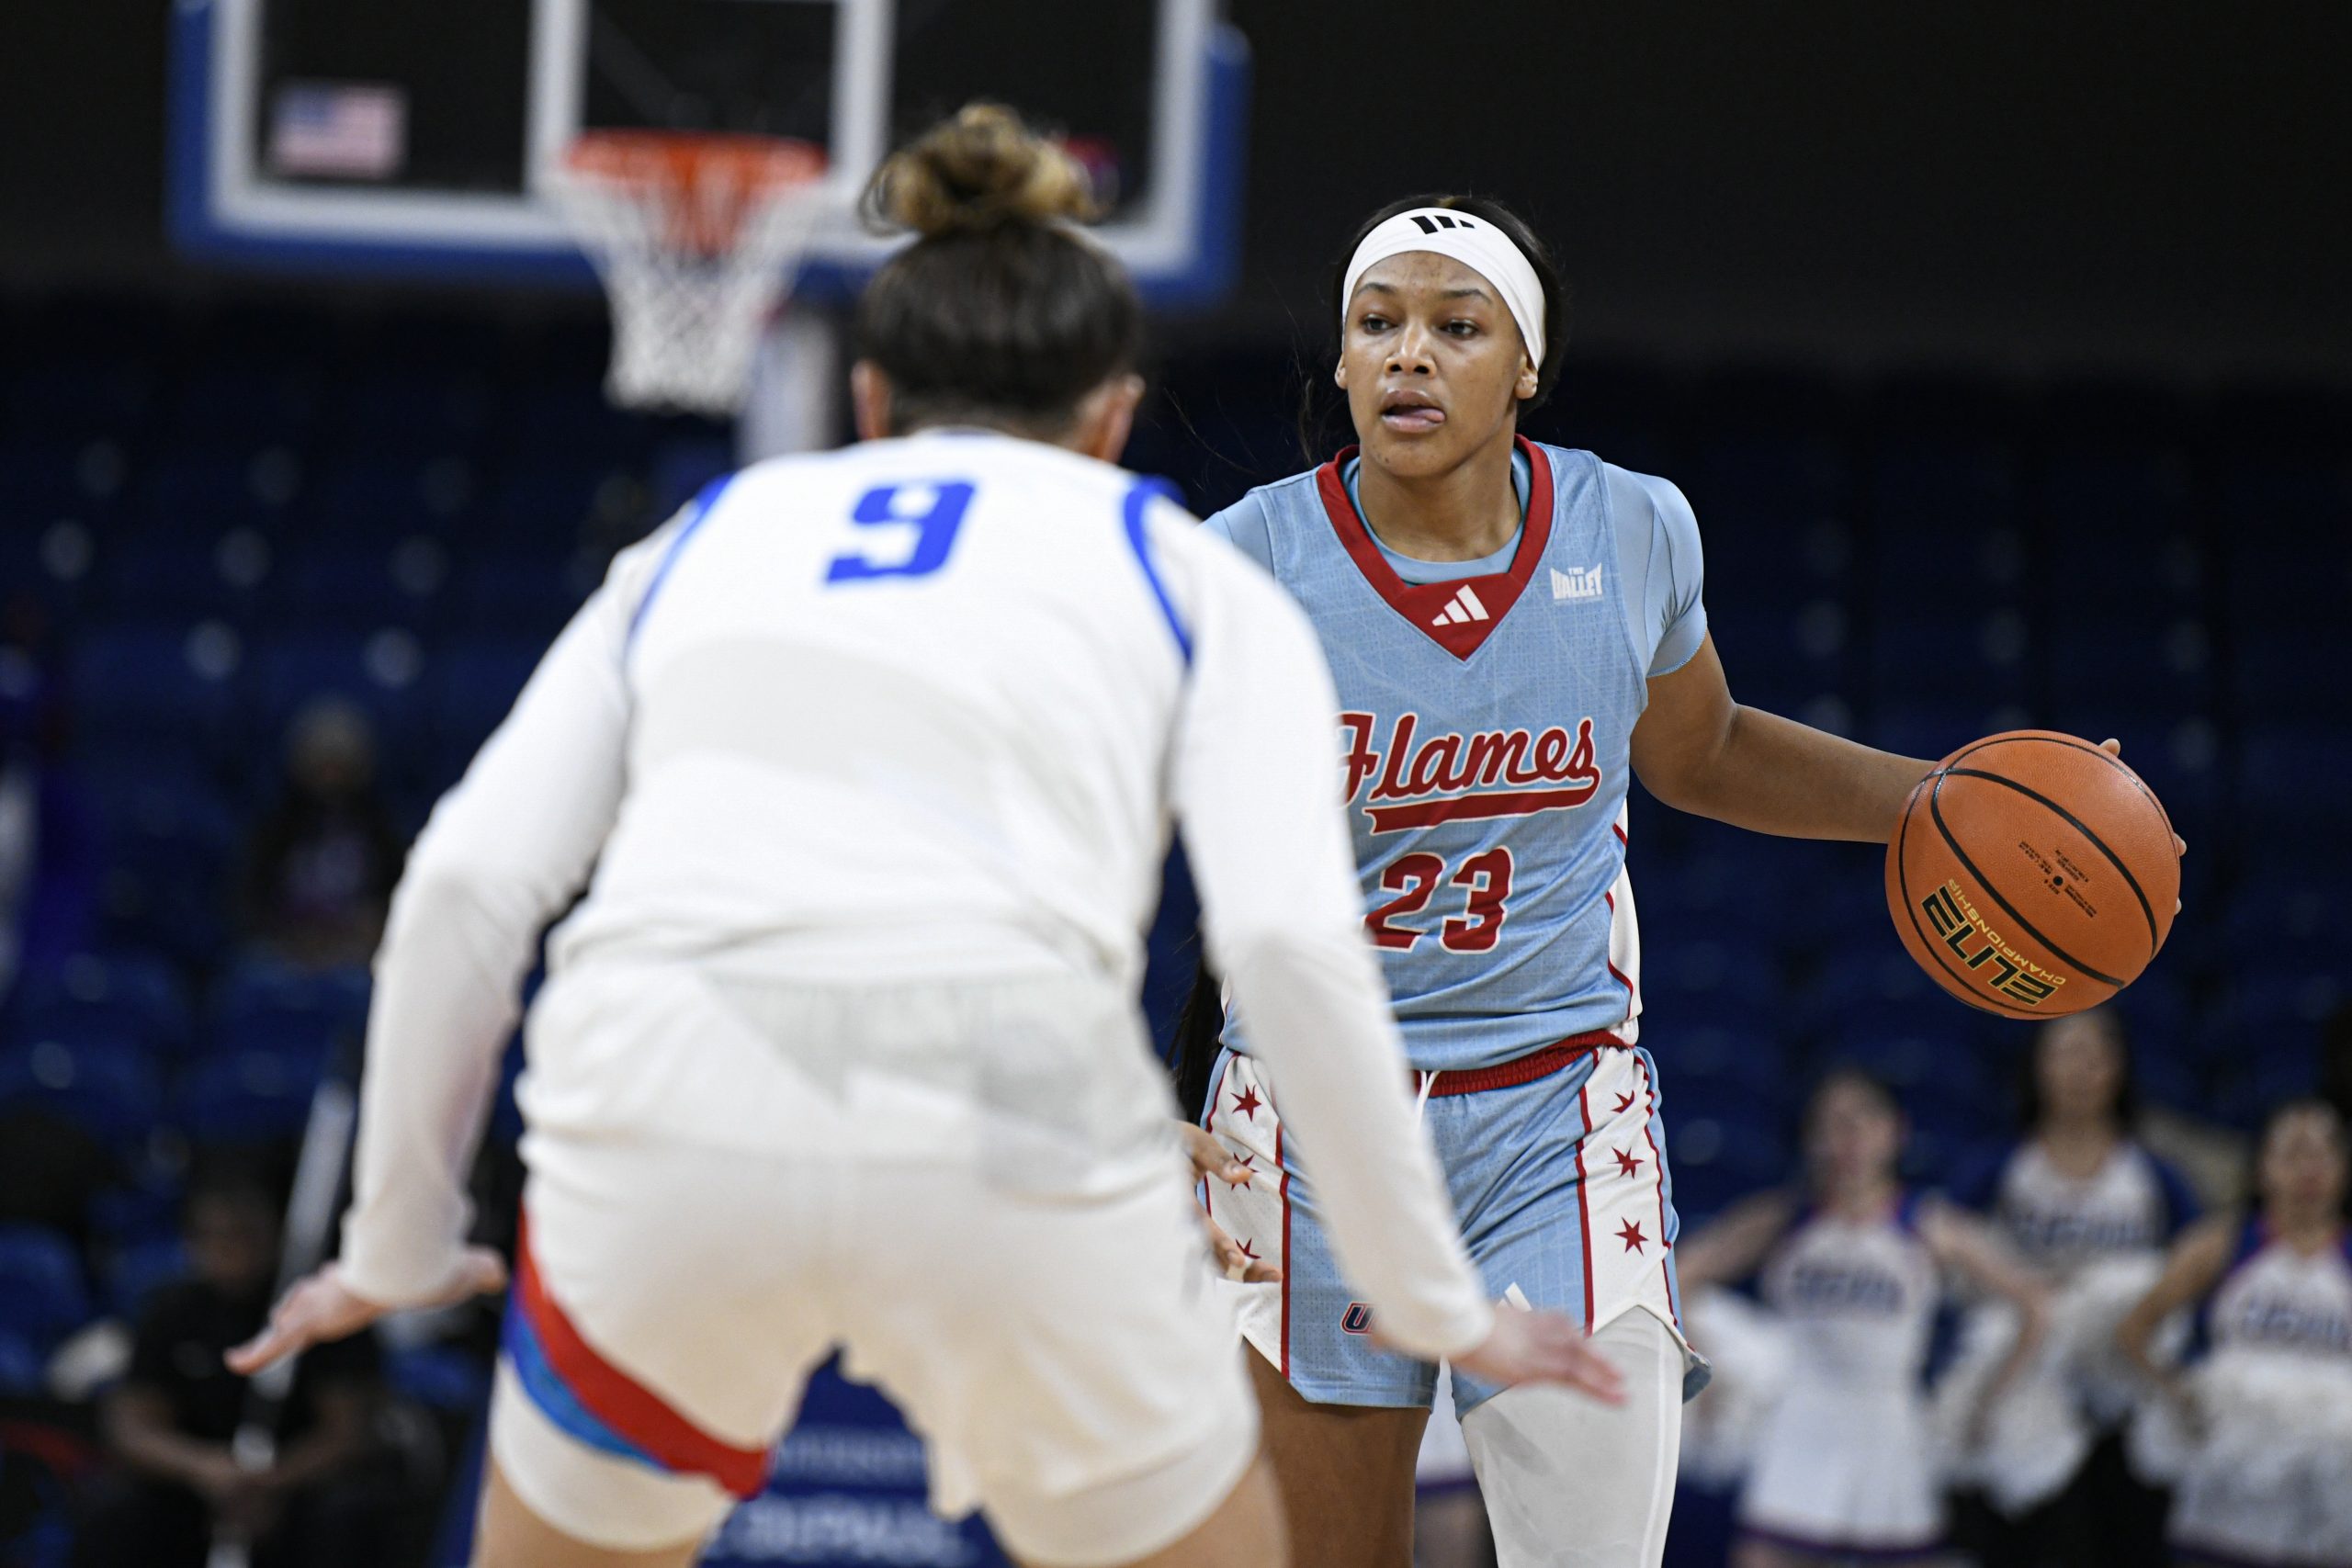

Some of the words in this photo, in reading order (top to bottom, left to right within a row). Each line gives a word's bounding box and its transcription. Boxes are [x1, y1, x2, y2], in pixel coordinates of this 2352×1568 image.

[825, 481, 977, 583] 9
[1551, 563, 1602, 600] VALLEY
[1336, 712, 1602, 808] Flames
[1364, 845, 1514, 954] 23
[1921, 886, 2059, 1007] ELITE
[1948, 878, 2066, 985] CHAMPIONSHIP
